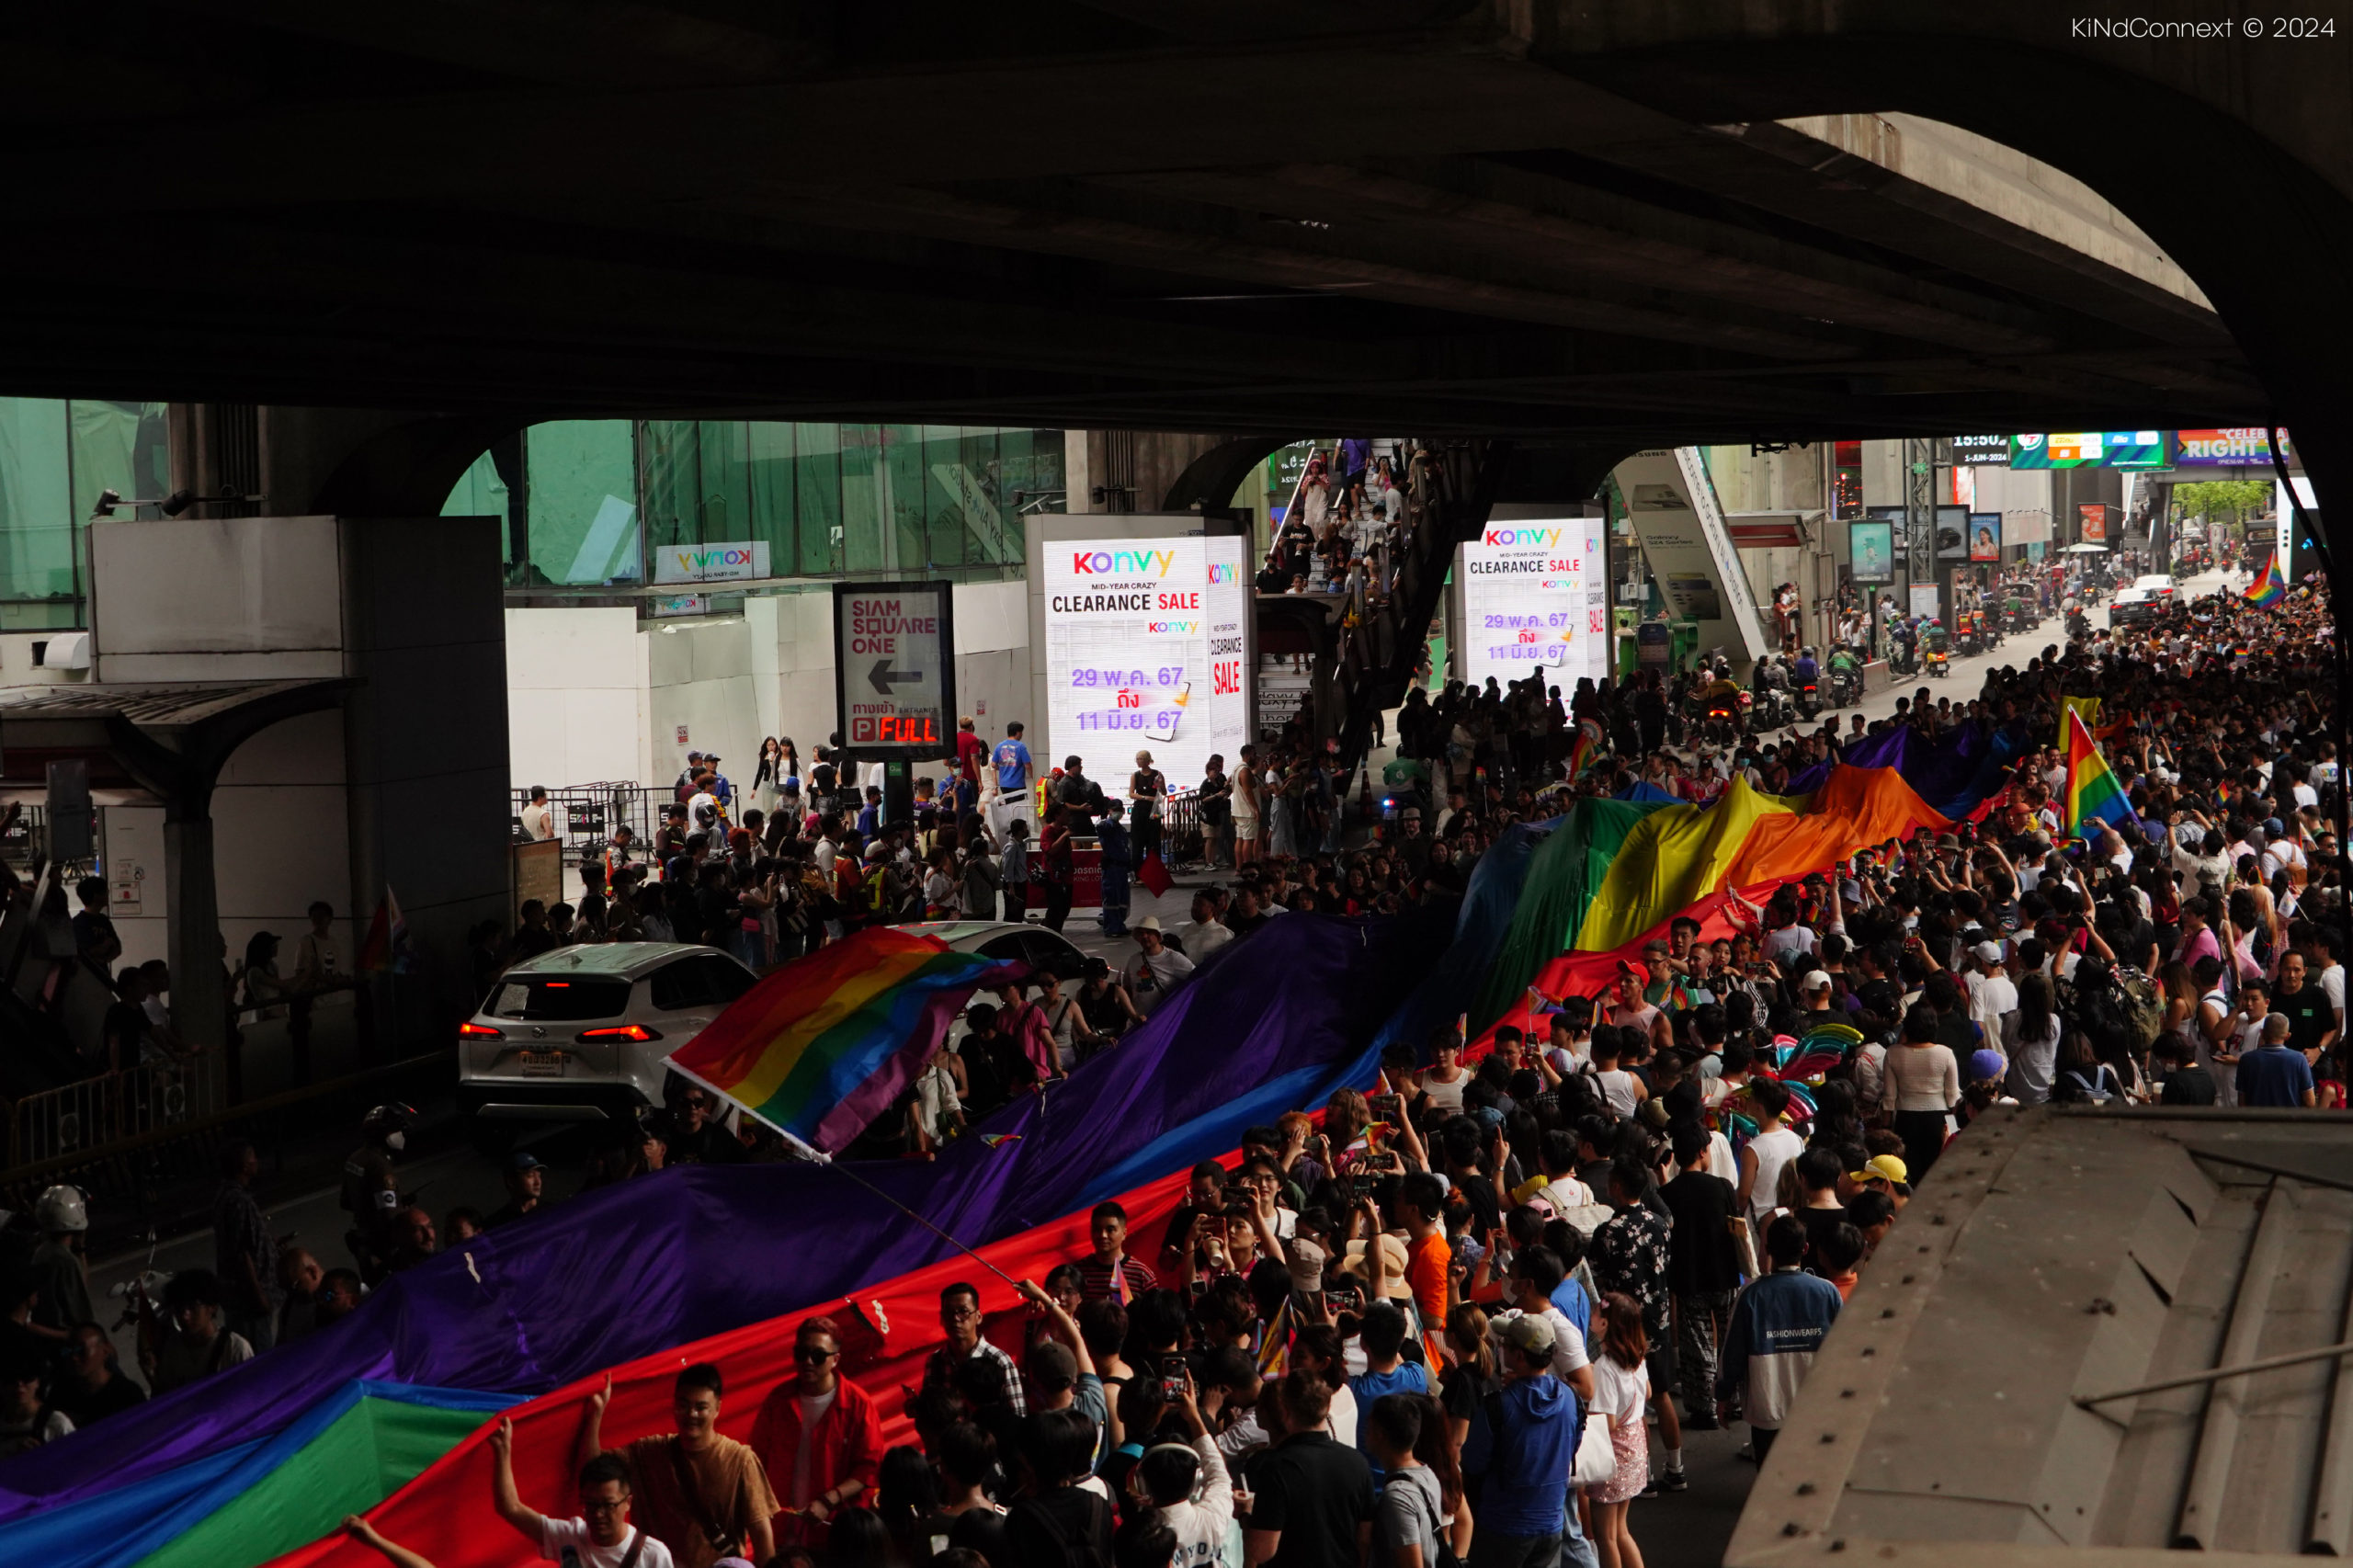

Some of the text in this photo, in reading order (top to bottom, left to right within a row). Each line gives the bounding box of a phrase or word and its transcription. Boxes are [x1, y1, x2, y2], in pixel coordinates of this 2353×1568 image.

[2188, 439, 2258, 458] RIGHT
[1471, 559, 1580, 574] CLEARANCE SALE
[852, 600, 901, 617] SIAM
[1052, 593, 1199, 612] CLEARANCE SALE
[853, 617, 936, 637] SQUARE
[1484, 614, 1504, 628] 29
[1549, 613, 1568, 627] 67
[1518, 629, 1535, 643] ถึง
[852, 638, 895, 653] ONE
[1211, 637, 1242, 655] CLEARANCE
[1488, 647, 1504, 660] 11
[1548, 645, 1567, 659] 67
[1072, 668, 1097, 687] 29
[1158, 667, 1184, 686] 67
[1214, 661, 1240, 695] SALE
[1117, 687, 1139, 708] ถึง
[853, 700, 894, 714] ทางเข้า
[881, 717, 937, 742] FULL
[1076, 712, 1098, 730] 11
[1157, 711, 1183, 729] 67
